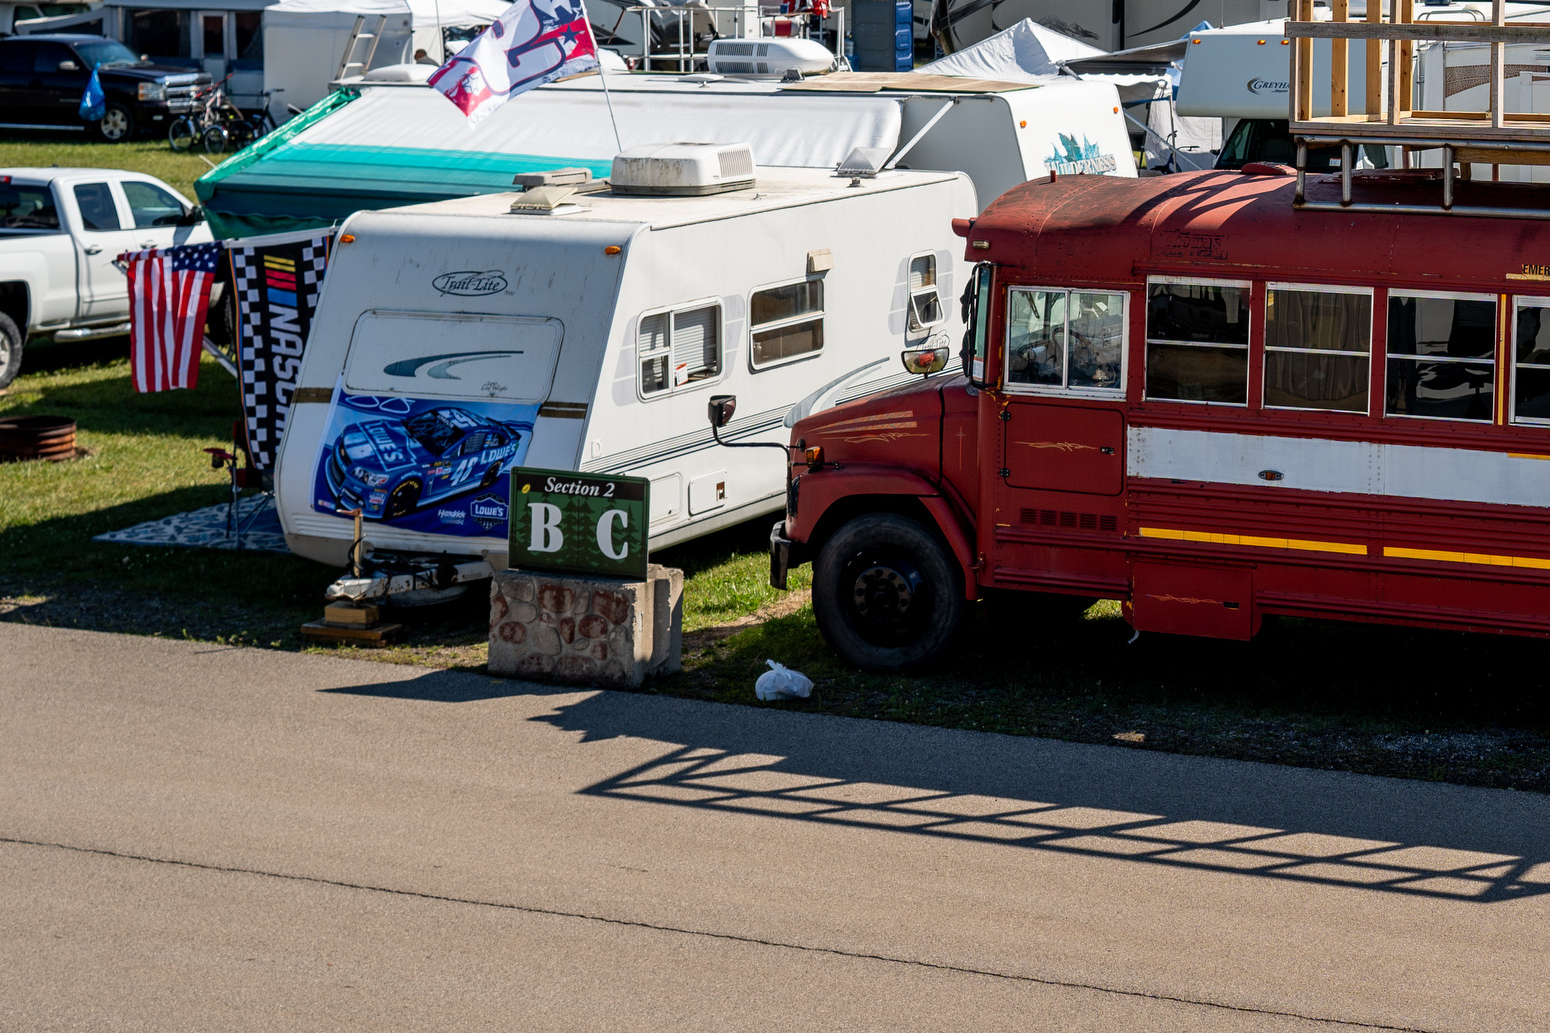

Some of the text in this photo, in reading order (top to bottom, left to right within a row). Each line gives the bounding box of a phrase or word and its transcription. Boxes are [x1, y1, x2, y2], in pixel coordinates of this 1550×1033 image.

[1044, 154, 1117, 175] WILDERNESS
[441, 275, 501, 292] Trail-Lite
[365, 422, 405, 462] LOWE'S
[480, 441, 517, 465] LOWE'S
[544, 476, 616, 498] Section 2
[475, 504, 504, 517] LOWE'S
[527, 502, 629, 560] B C
